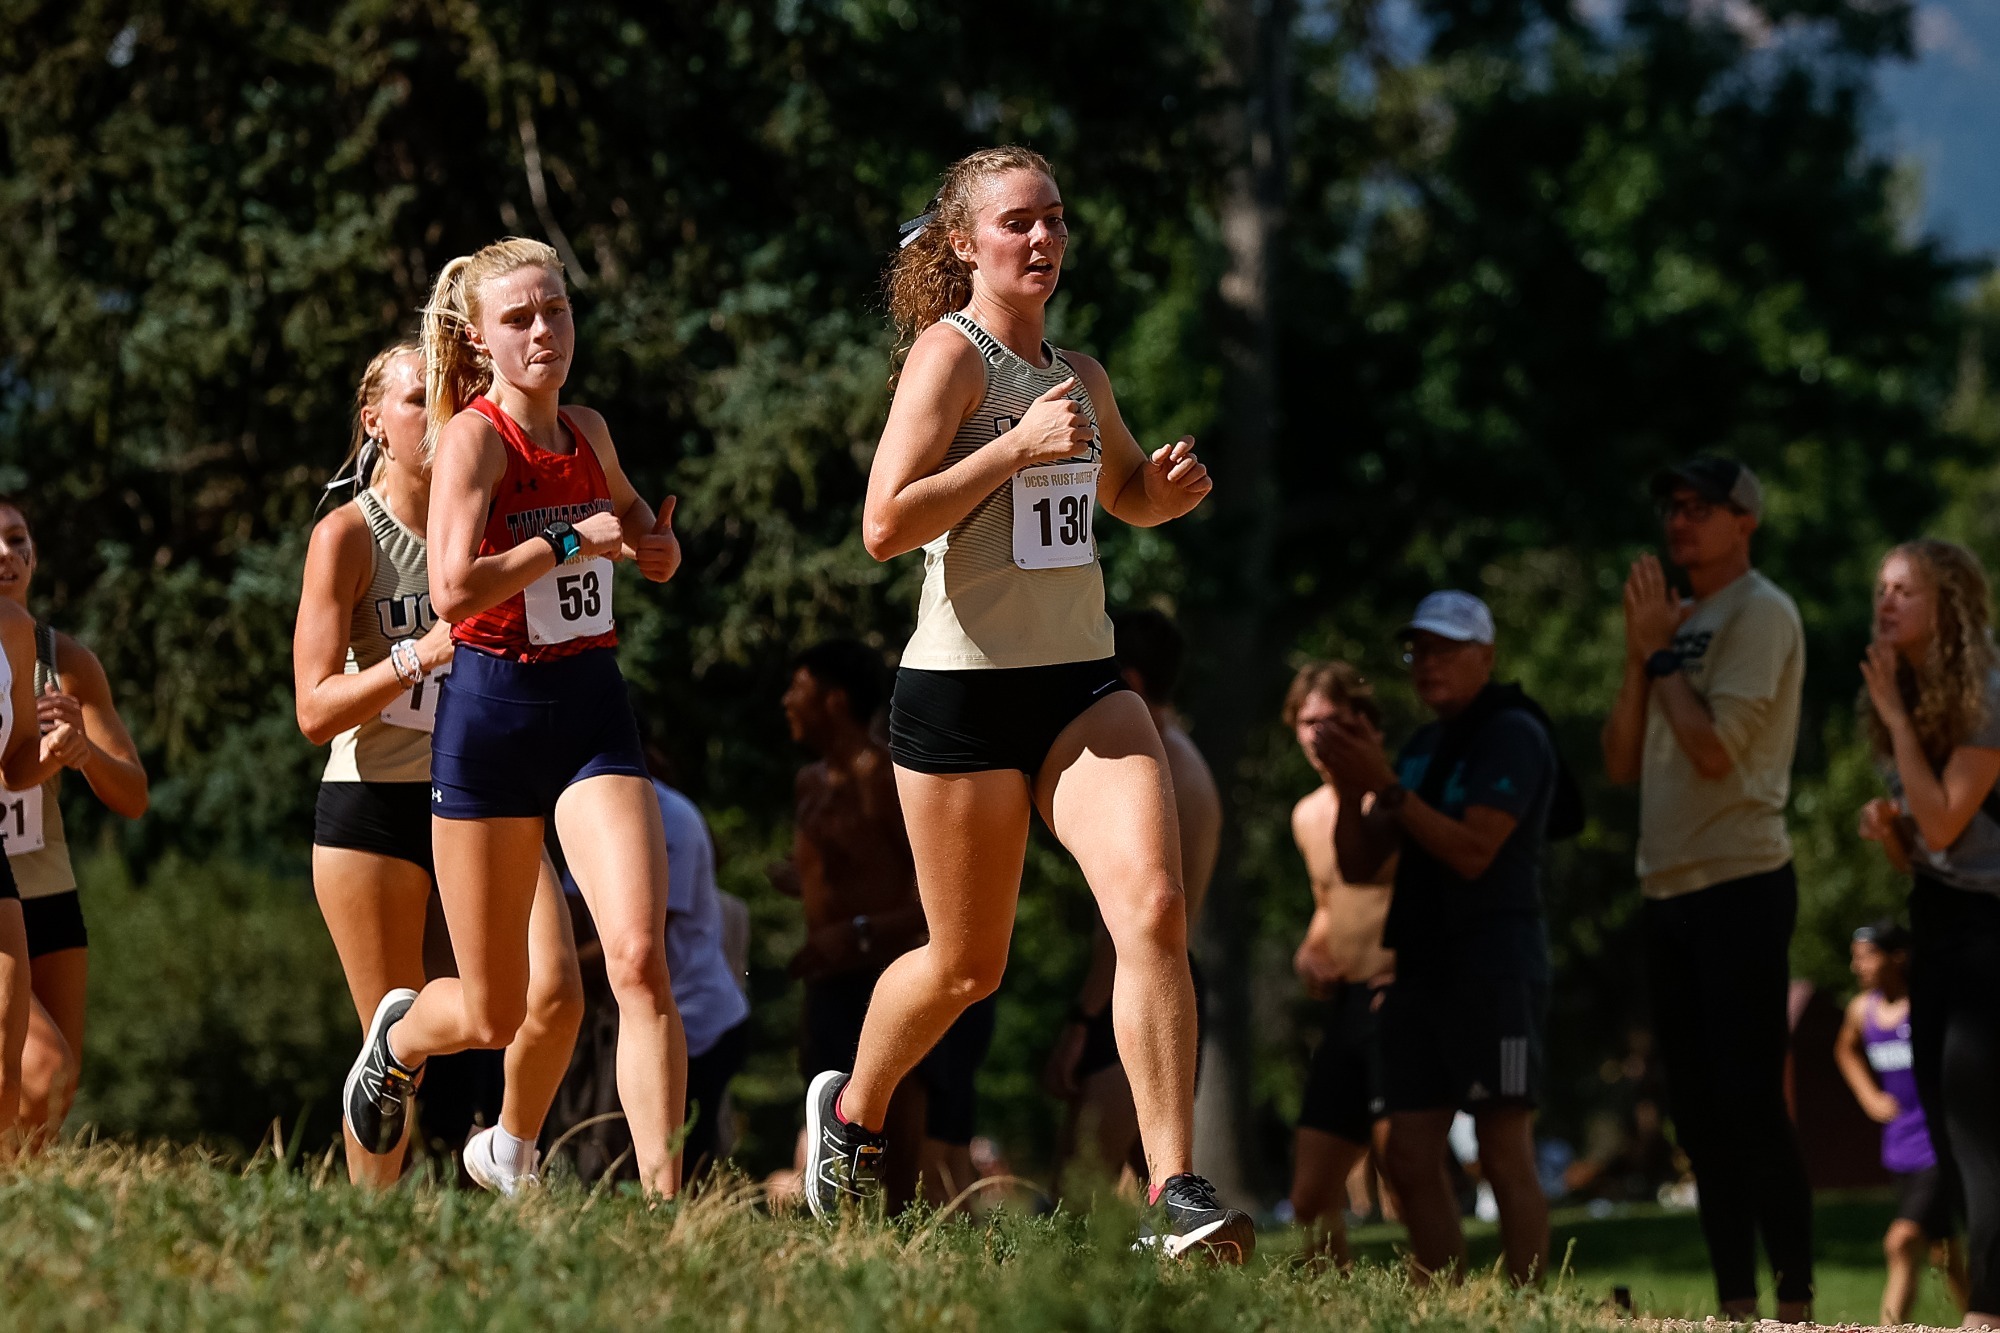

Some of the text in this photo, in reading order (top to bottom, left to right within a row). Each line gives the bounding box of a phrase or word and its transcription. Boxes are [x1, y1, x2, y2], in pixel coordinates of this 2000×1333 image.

[1024, 471, 1093, 488] UCCS RUST-BUSTER
[1033, 493, 1089, 547] 130
[556, 571, 601, 621] 53
